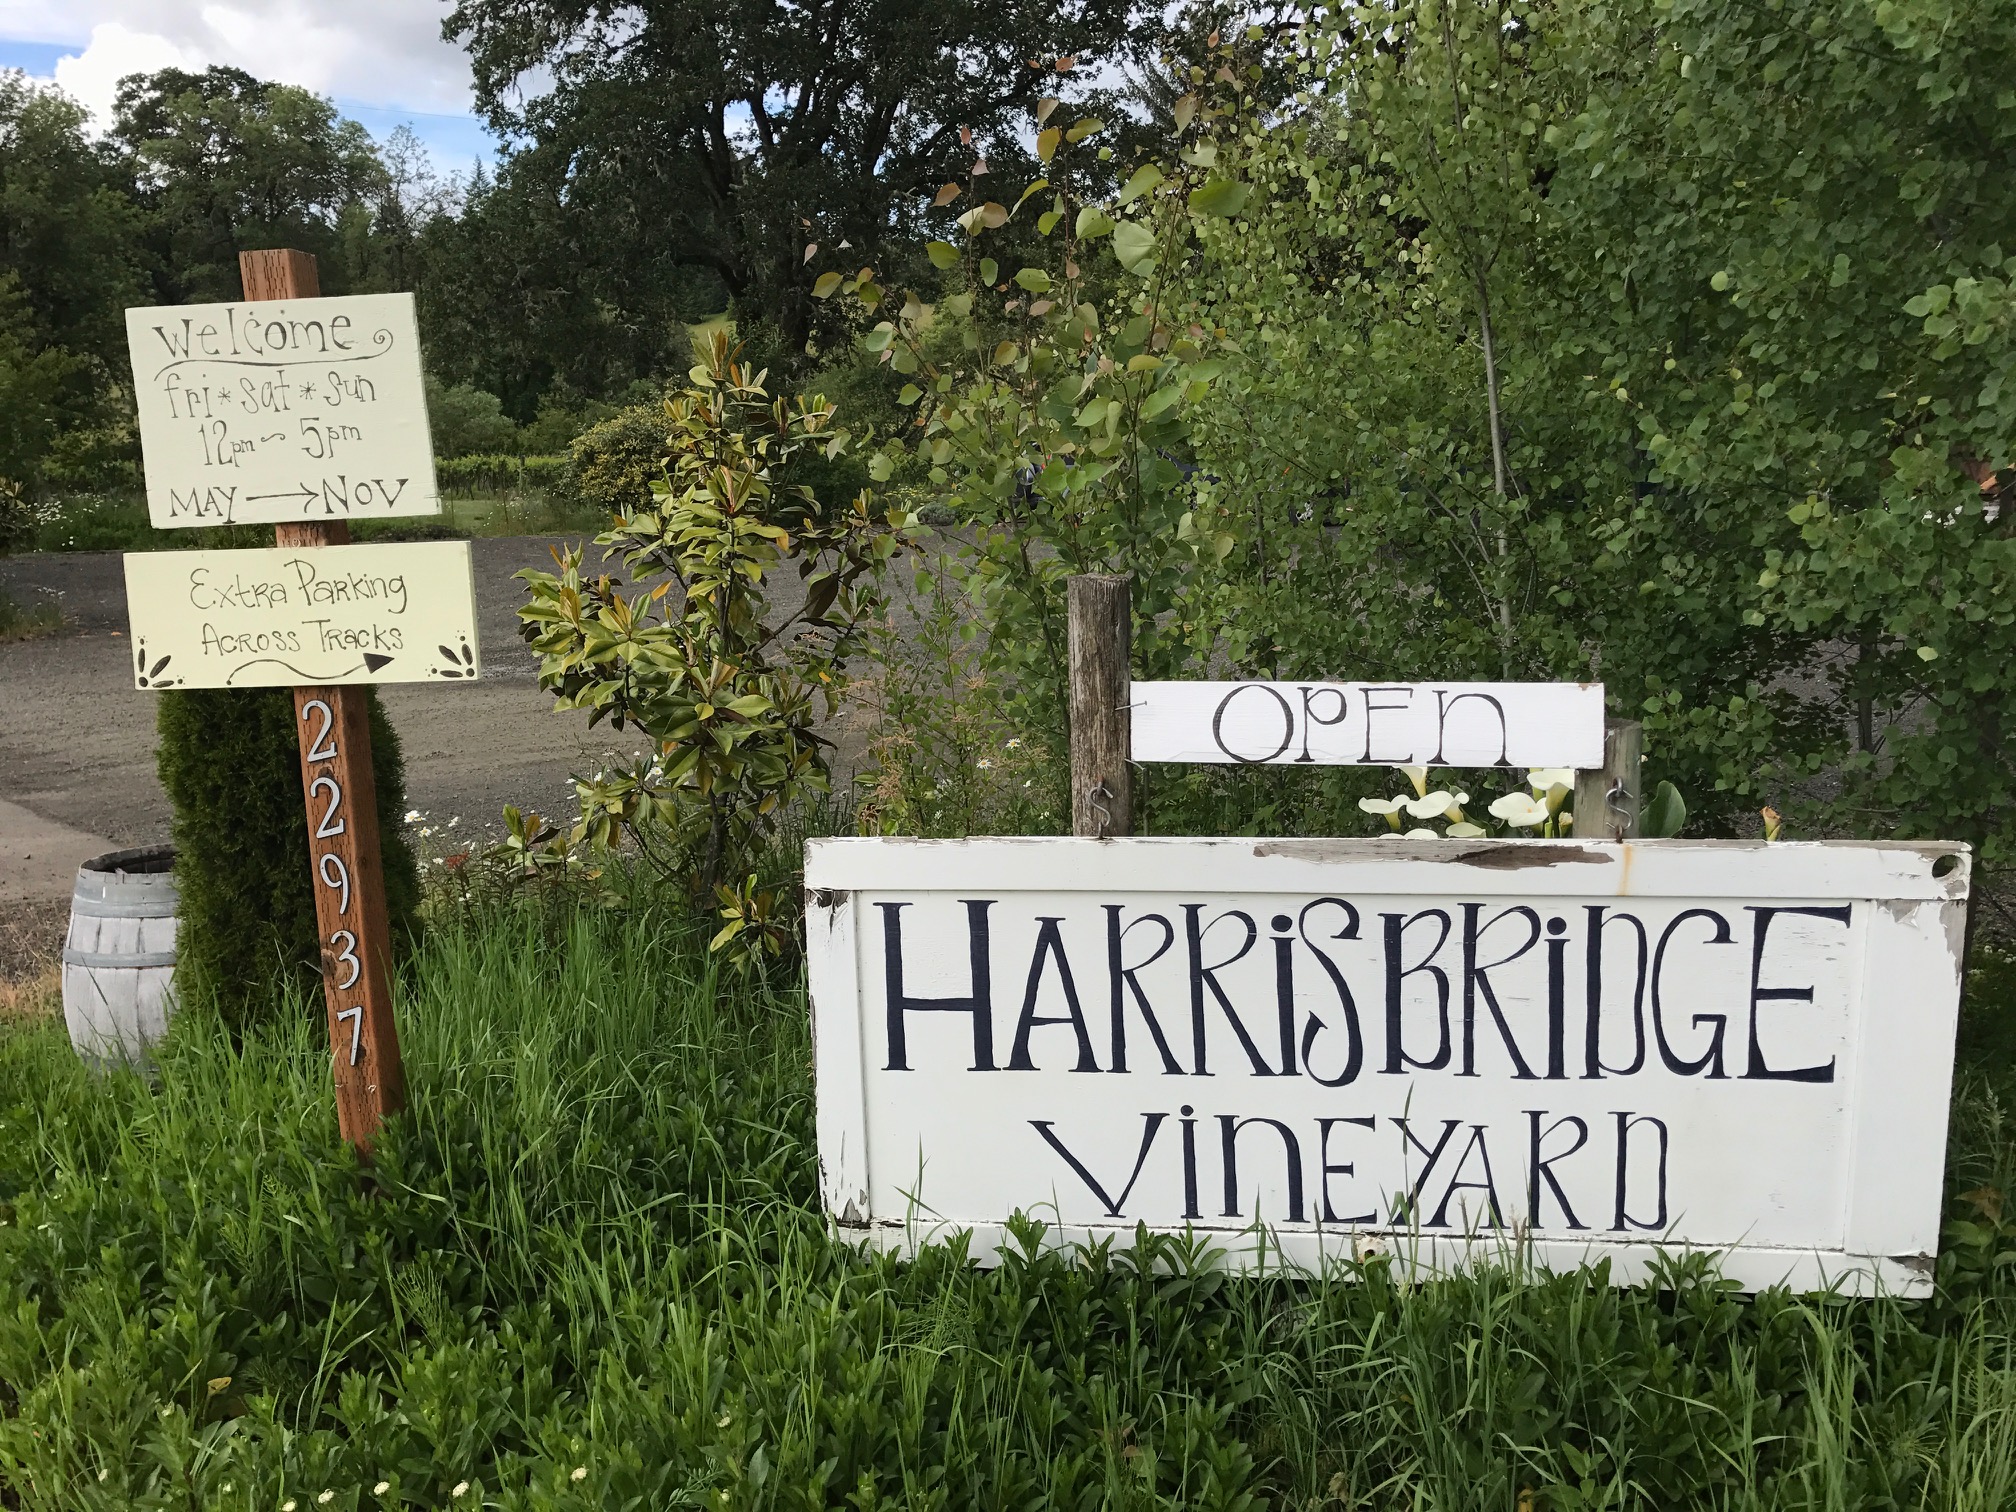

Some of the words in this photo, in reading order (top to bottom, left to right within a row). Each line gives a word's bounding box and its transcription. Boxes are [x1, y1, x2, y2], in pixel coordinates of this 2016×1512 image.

[152, 307, 352, 359] Welcome
[198, 419, 255, 467] 12pm
[299, 416, 362, 459] 5pm
[169, 486, 237, 524] MAY
